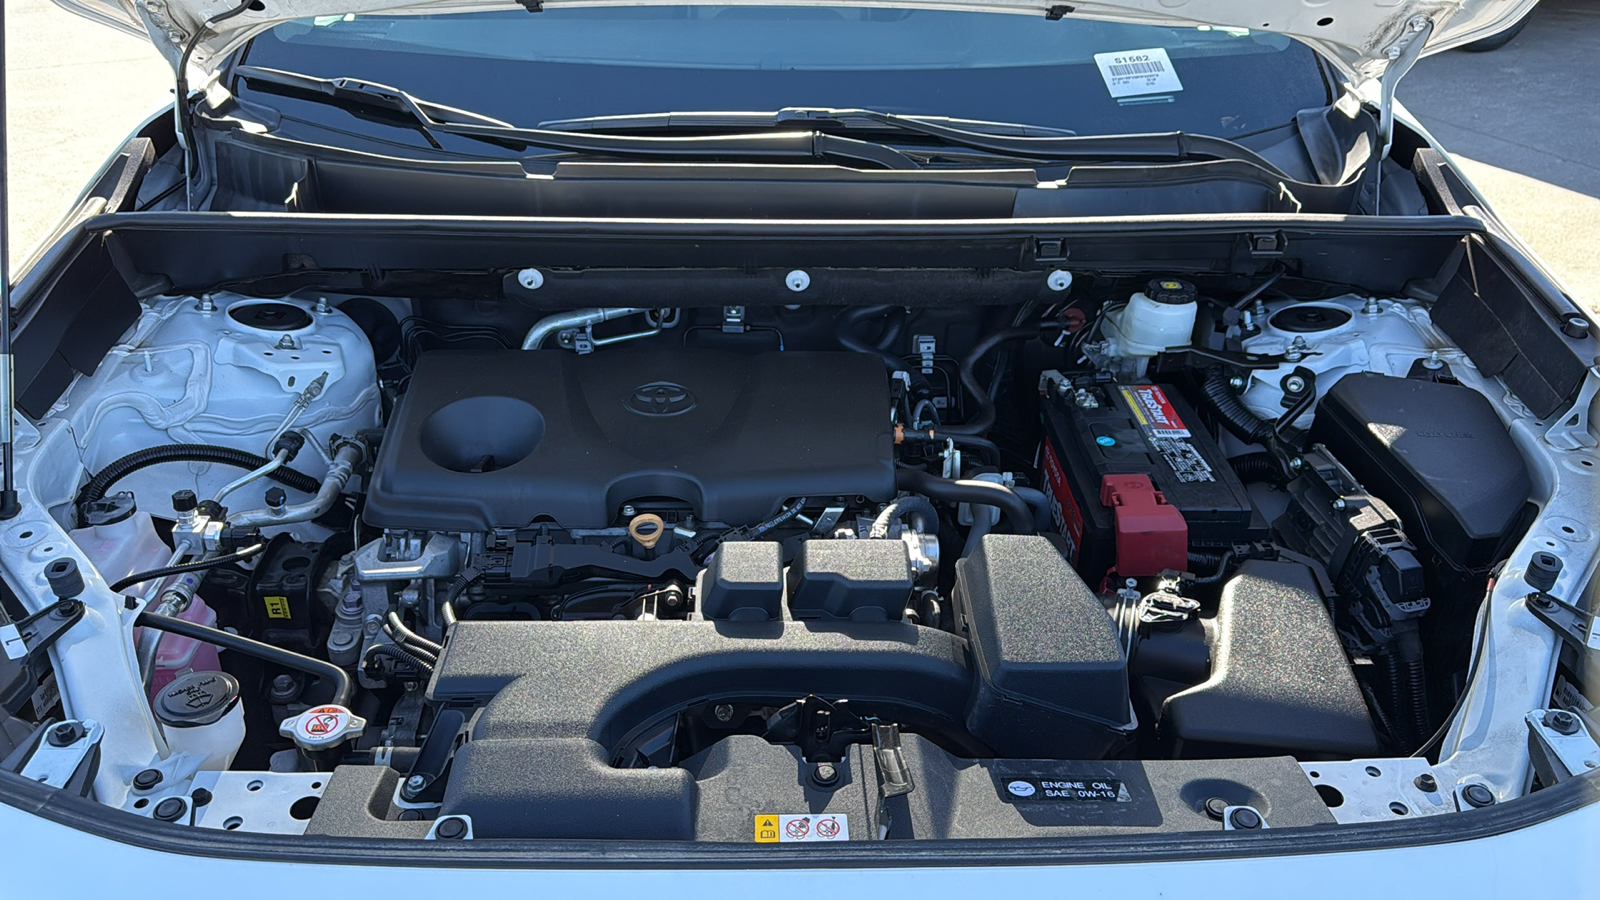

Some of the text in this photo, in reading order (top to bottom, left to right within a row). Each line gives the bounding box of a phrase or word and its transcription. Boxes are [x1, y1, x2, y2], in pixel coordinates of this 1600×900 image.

[270, 602, 281, 615] R1
[1041, 781, 1112, 790] ENGINE OIL
[1077, 790, 1115, 798] 0W-16
